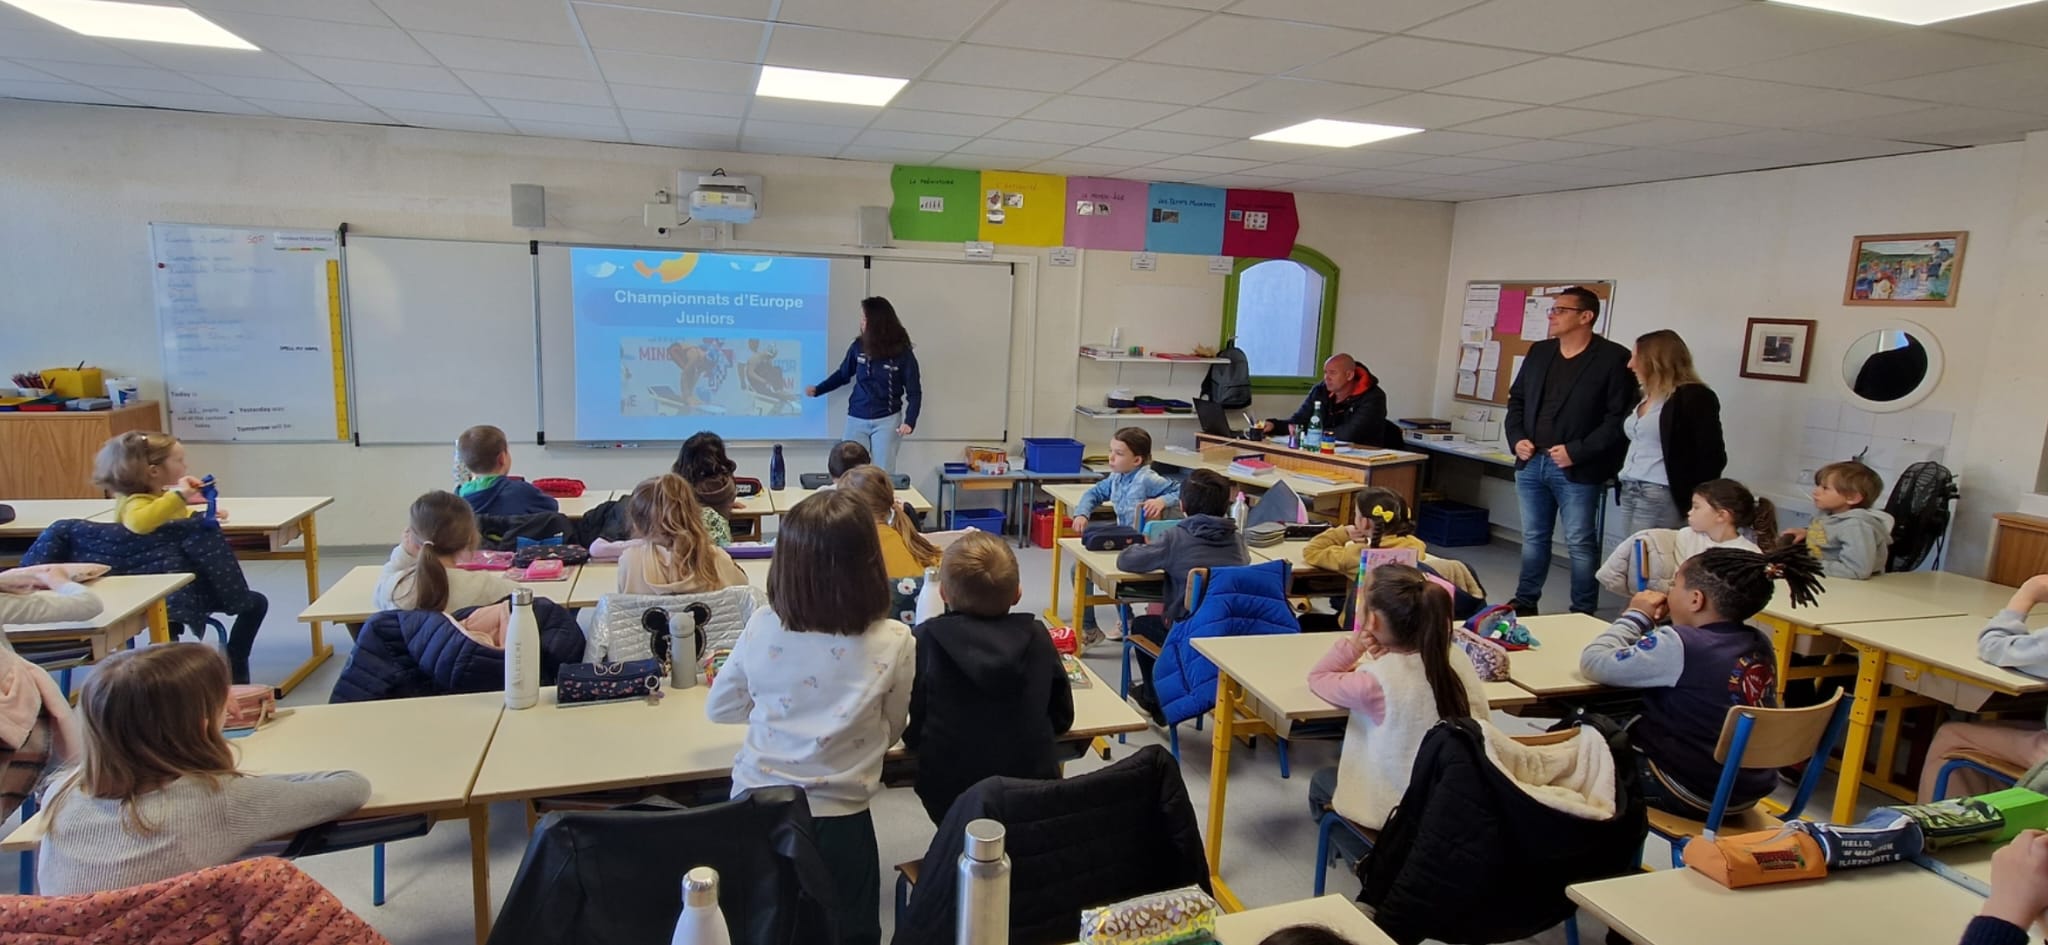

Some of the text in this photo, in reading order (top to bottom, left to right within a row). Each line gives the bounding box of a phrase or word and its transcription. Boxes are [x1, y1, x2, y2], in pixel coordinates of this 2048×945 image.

[614, 290, 804, 310] Championnats d'Europe
[676, 311, 735, 325] Juniors
[1841, 840, 1872, 848] HELLO,
